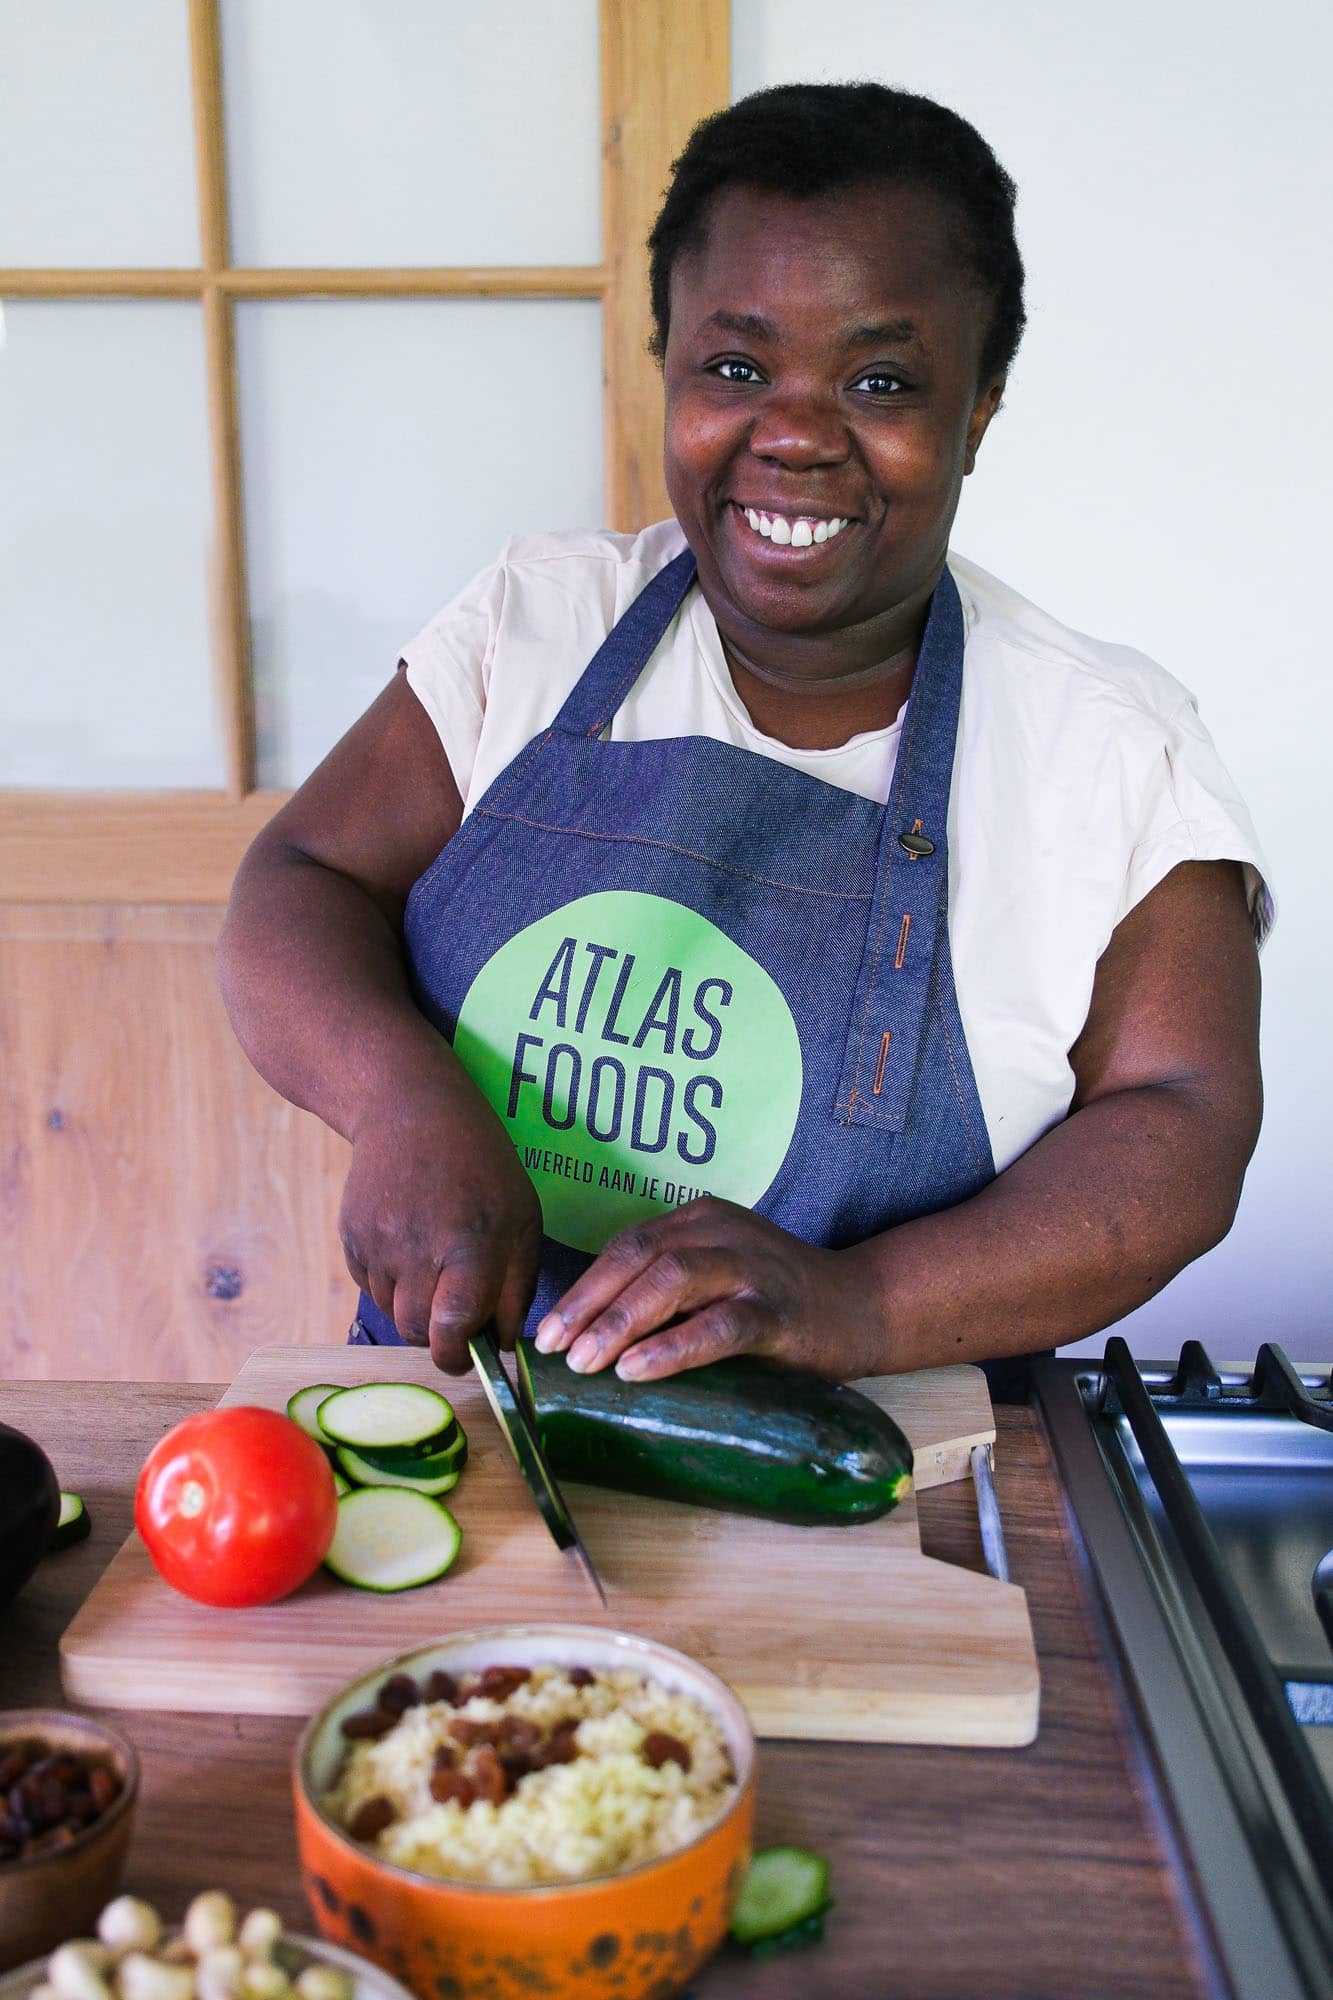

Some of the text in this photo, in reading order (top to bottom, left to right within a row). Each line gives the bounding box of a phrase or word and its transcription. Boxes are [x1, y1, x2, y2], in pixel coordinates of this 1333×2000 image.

[529, 937, 733, 1060] ATLAS
[506, 1032, 723, 1165] FOODS
[525, 1146, 713, 1206] WERELD AAN JE DEU
